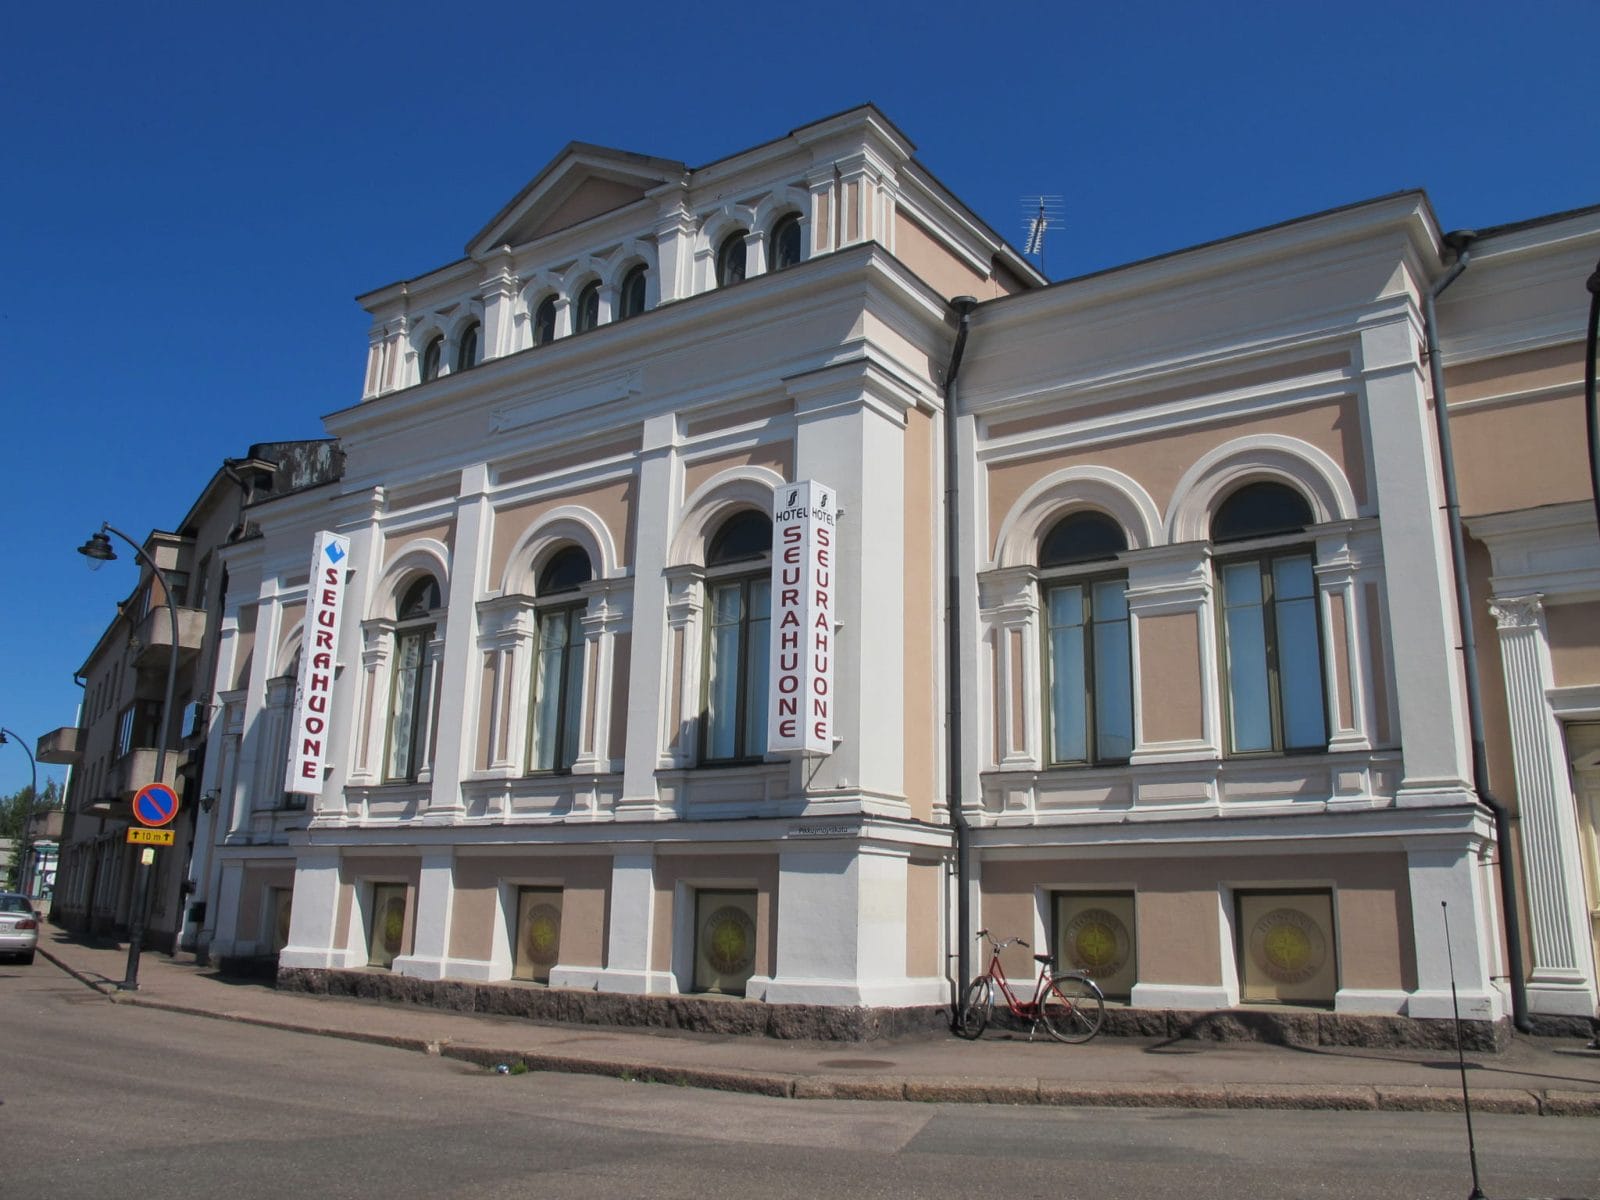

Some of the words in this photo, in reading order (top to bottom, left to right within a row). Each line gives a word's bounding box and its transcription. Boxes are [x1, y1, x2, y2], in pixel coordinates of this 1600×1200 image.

[775, 507, 808, 522] HOTEL
[811, 508, 834, 526] HOTEL
[301, 568, 339, 779] SEURAHUONE
[778, 525, 801, 738] SEURAHUONE
[813, 528, 830, 740] SEURAHUONE
[142, 831, 151, 841] 10
